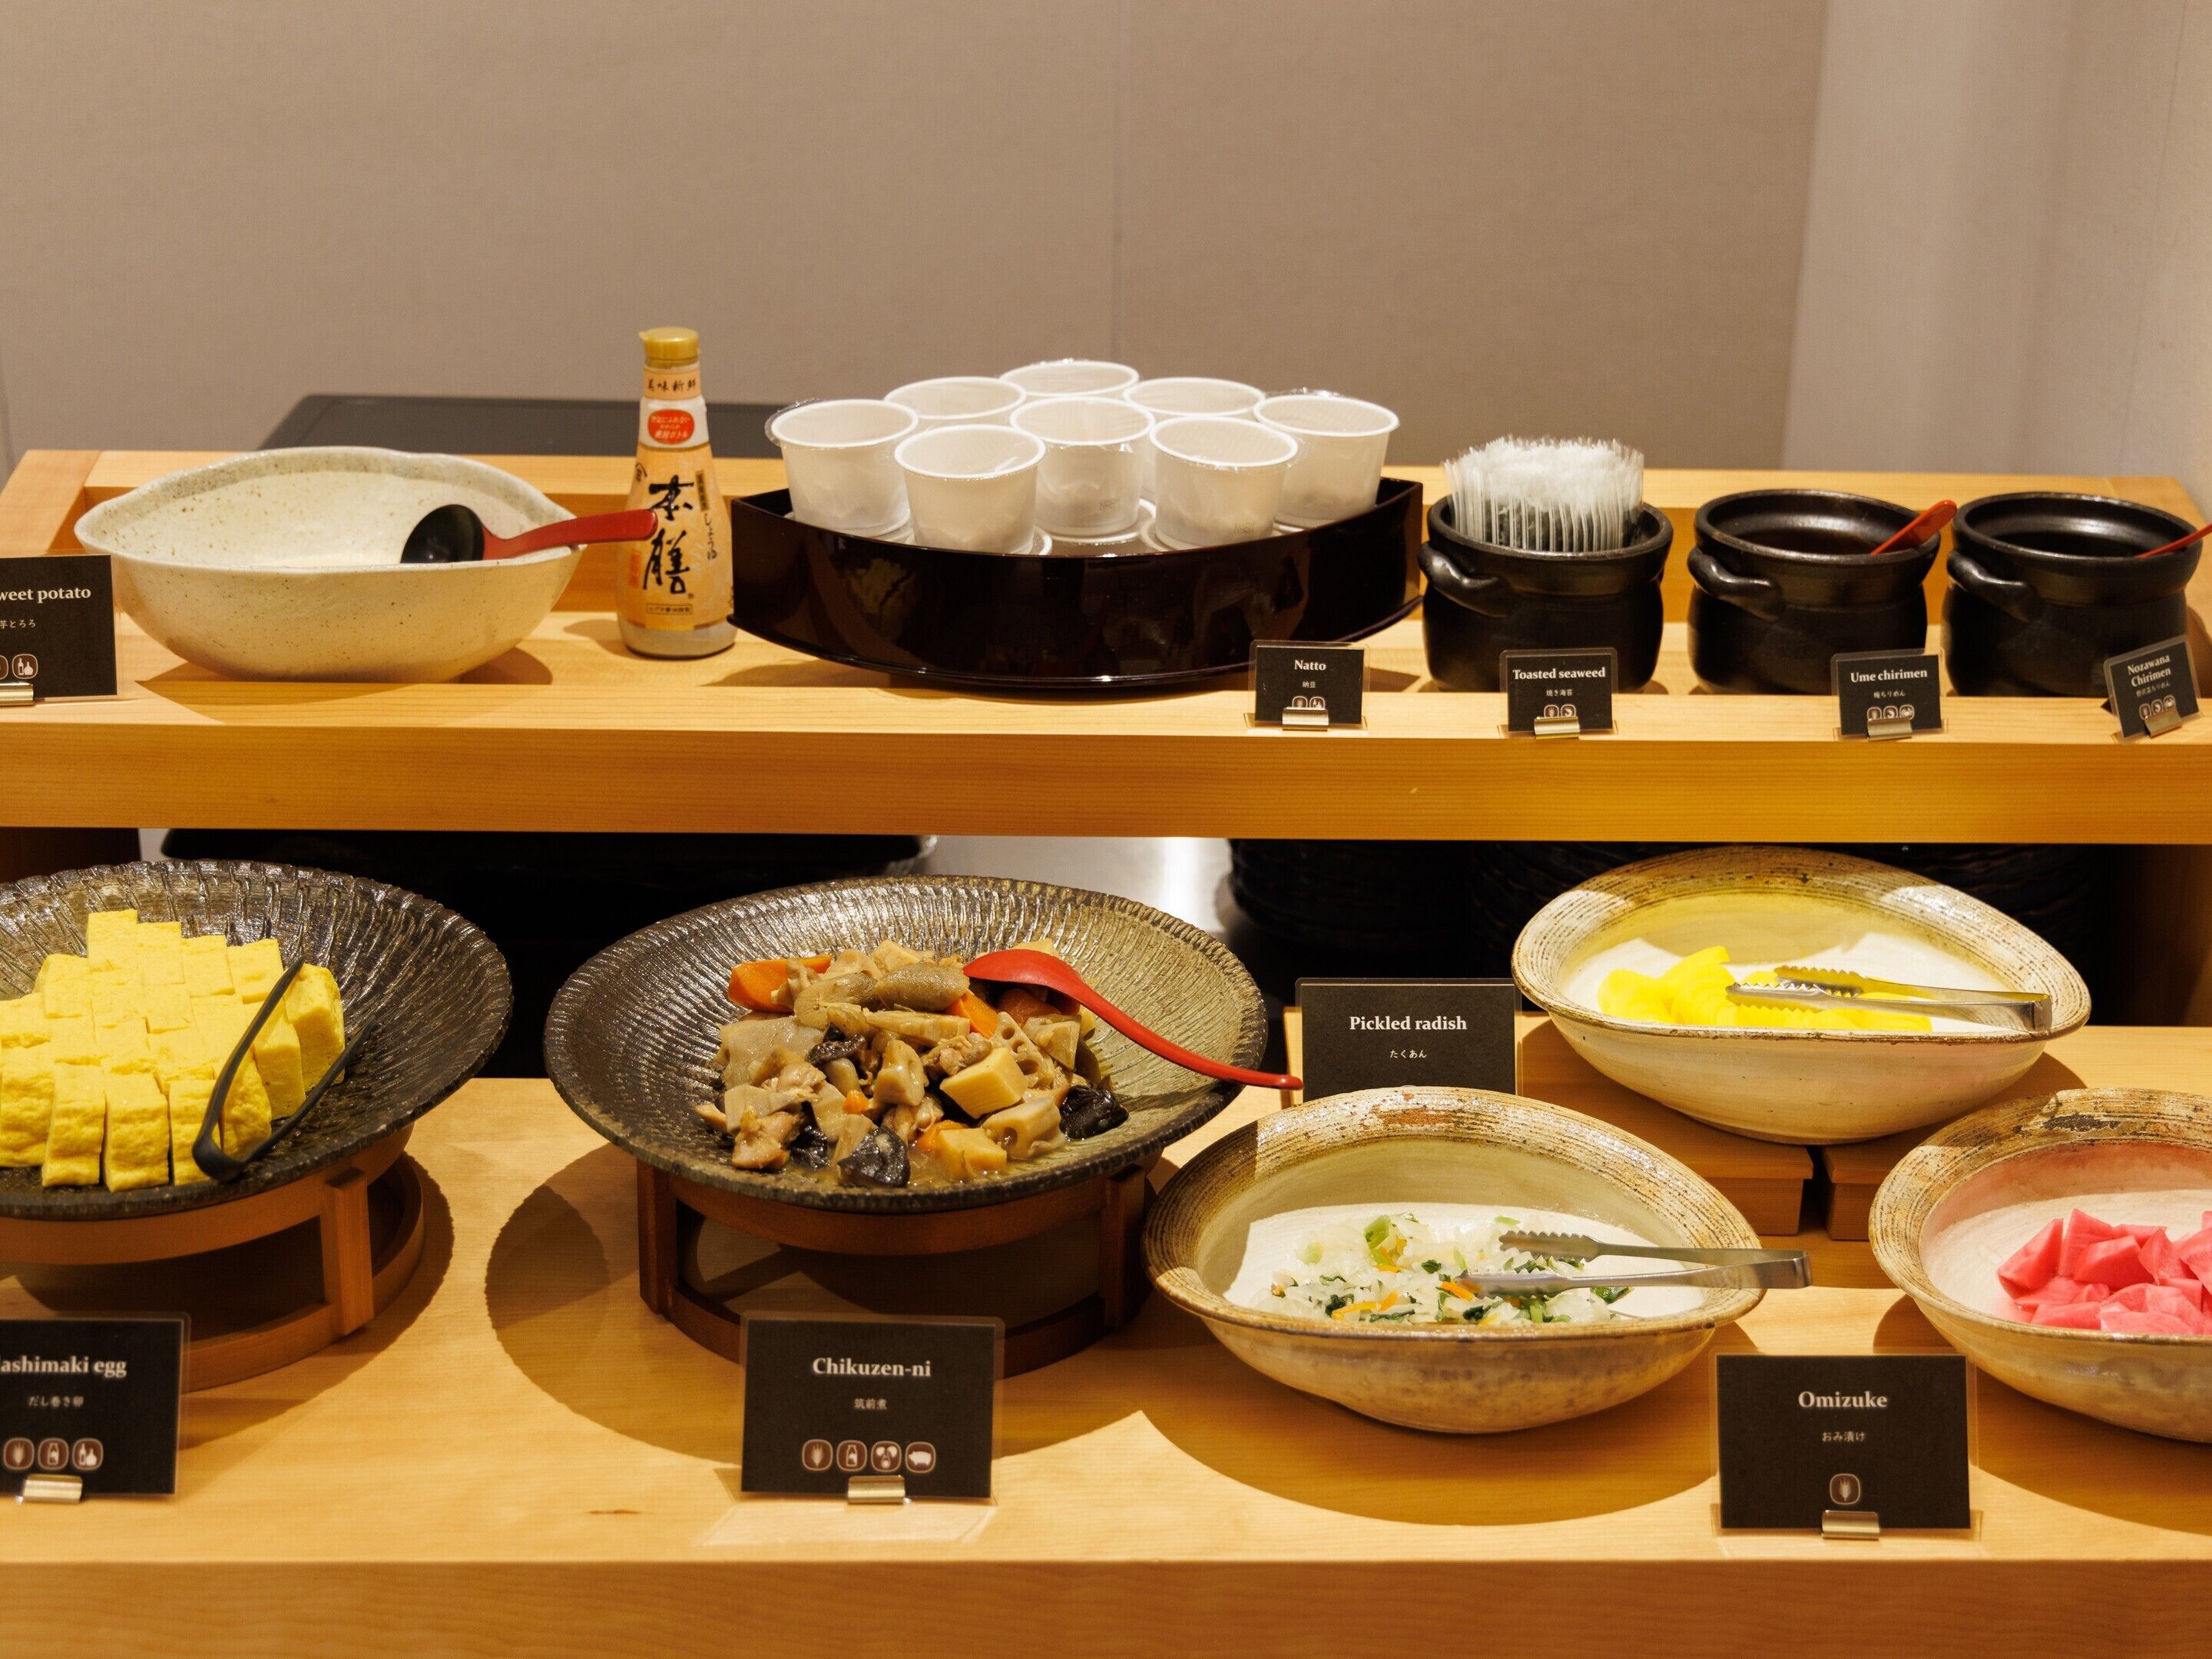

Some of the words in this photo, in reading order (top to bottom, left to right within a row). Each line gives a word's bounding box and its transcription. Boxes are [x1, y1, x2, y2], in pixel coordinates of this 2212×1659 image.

[642, 475, 694, 594] 本膳
[38, 587, 91, 604] potato
[1293, 659, 1326, 671] Natto
[1512, 667, 1557, 680] Toasted
[1558, 667, 1606, 678] seaweed
[2127, 654, 2171, 676] Nozawana
[1850, 671, 1876, 683] Ume
[1877, 668, 1928, 681] chirimen
[2131, 667, 2172, 687] Chirimen
[1349, 1015, 1411, 1031] Pickled
[1415, 1015, 1468, 1031] radish
[1389, 1049, 1428, 1059] たくあん
[0, 1356, 89, 1373] ashimaki
[94, 1360, 127, 1379] egg
[813, 1358, 932, 1377] Chikuzen-ni
[1798, 1391, 1888, 1409] Omizuke
[1822, 1431, 1866, 1442] おみ漬け
